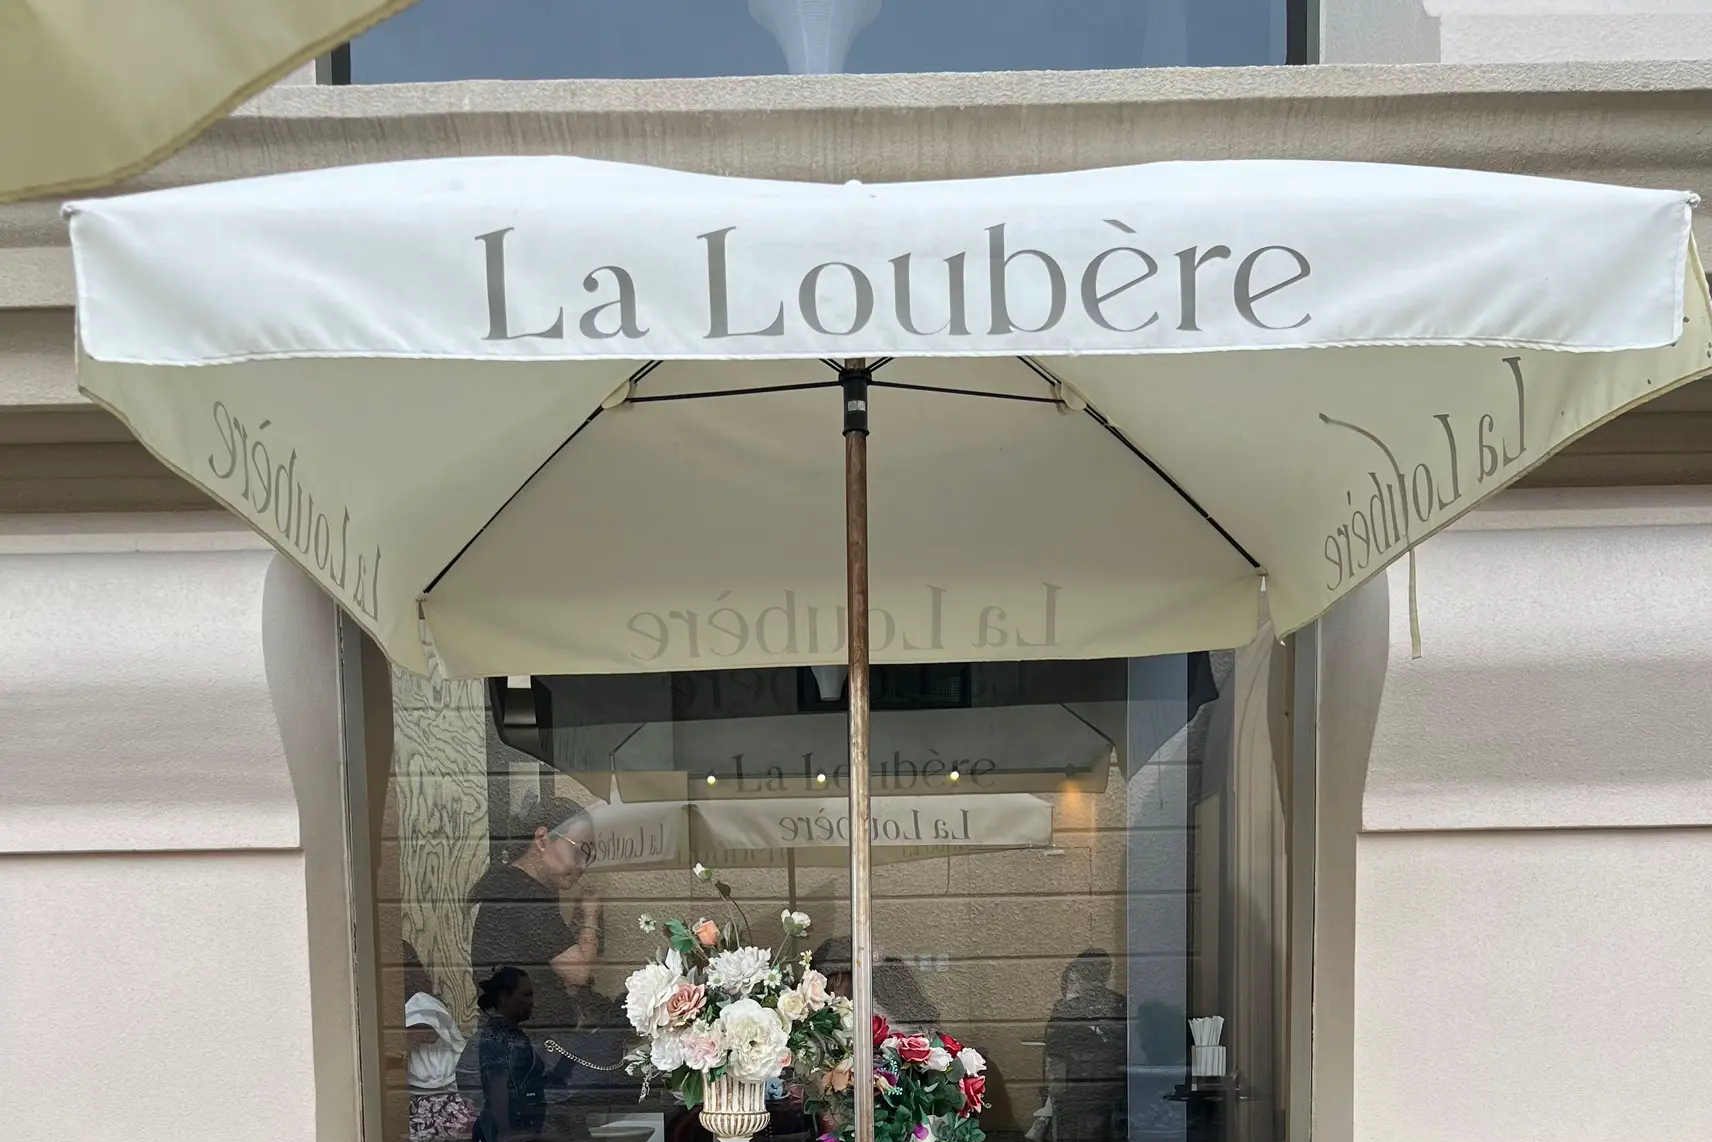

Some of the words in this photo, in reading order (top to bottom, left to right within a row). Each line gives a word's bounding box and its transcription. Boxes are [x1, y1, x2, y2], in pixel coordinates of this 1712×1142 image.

[474, 225, 650, 341] La
[696, 218, 1313, 340] Loubère
[730, 752, 789, 793] La
